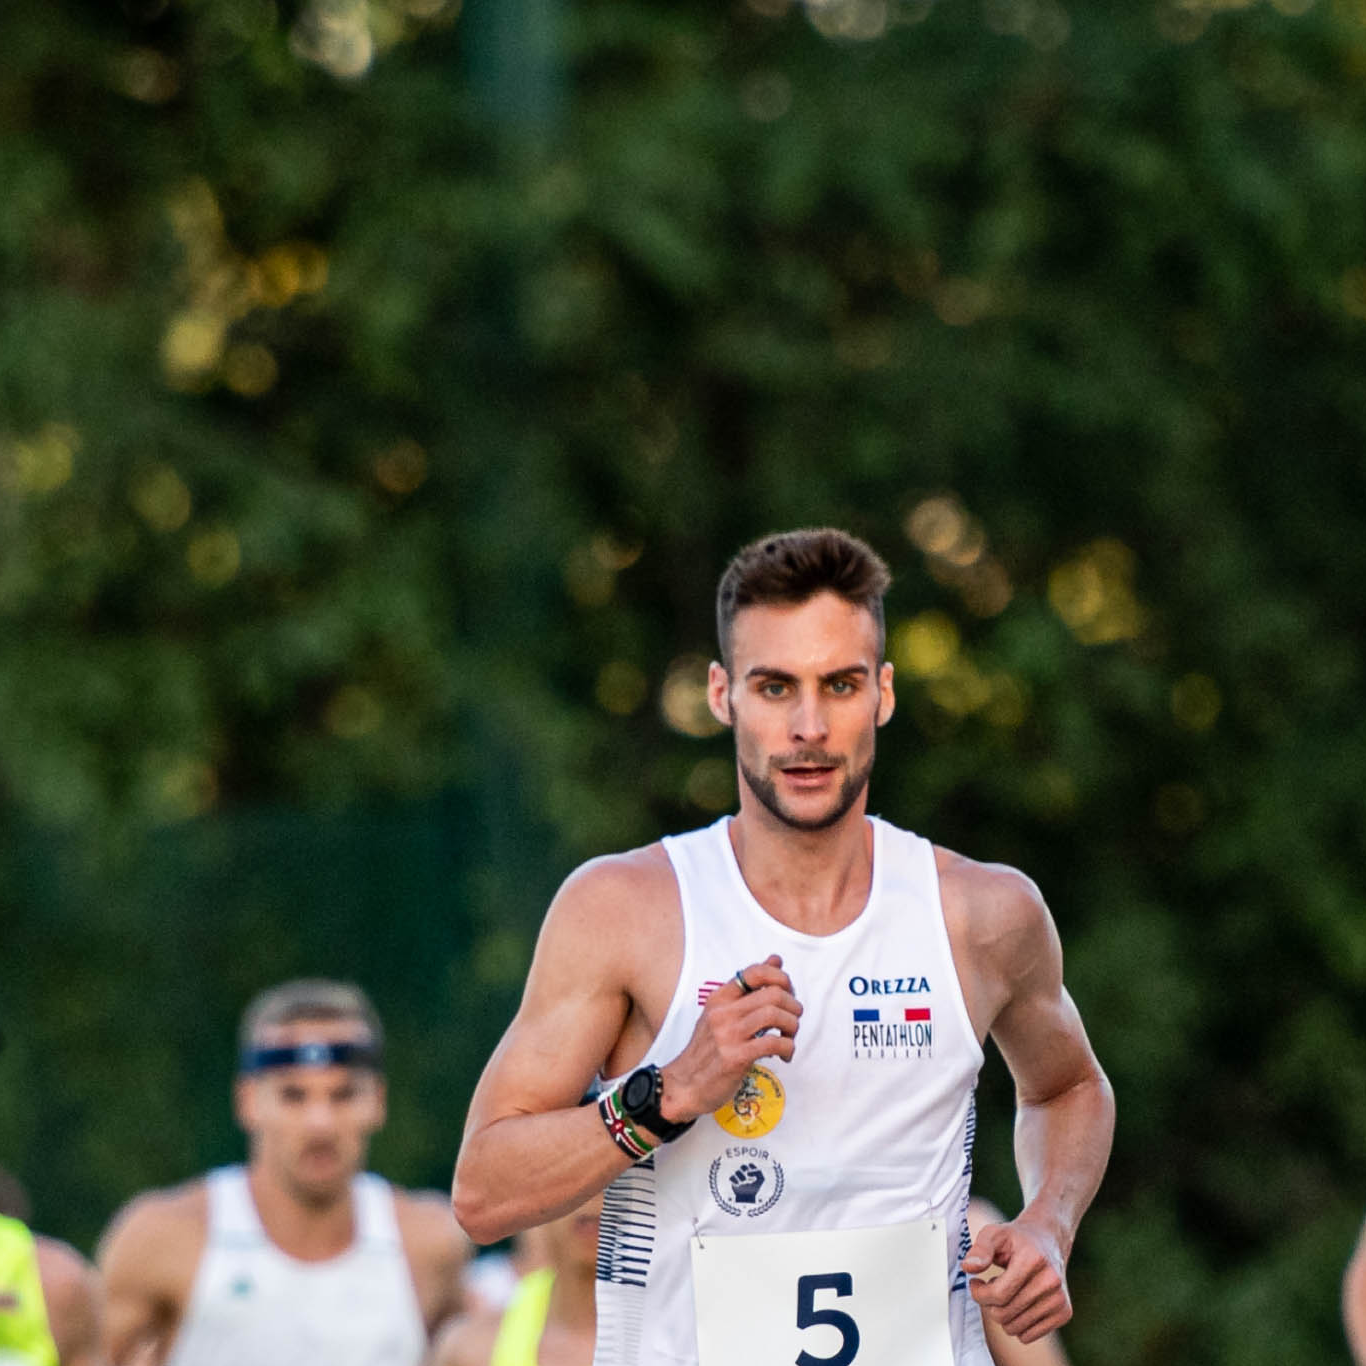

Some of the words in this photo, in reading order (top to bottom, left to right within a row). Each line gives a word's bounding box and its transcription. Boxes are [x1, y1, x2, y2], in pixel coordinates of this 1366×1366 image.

[848, 976, 931, 996] OREZZA
[853, 1023, 932, 1047] PENTATHLON
[725, 1146, 770, 1161] ESPOIR
